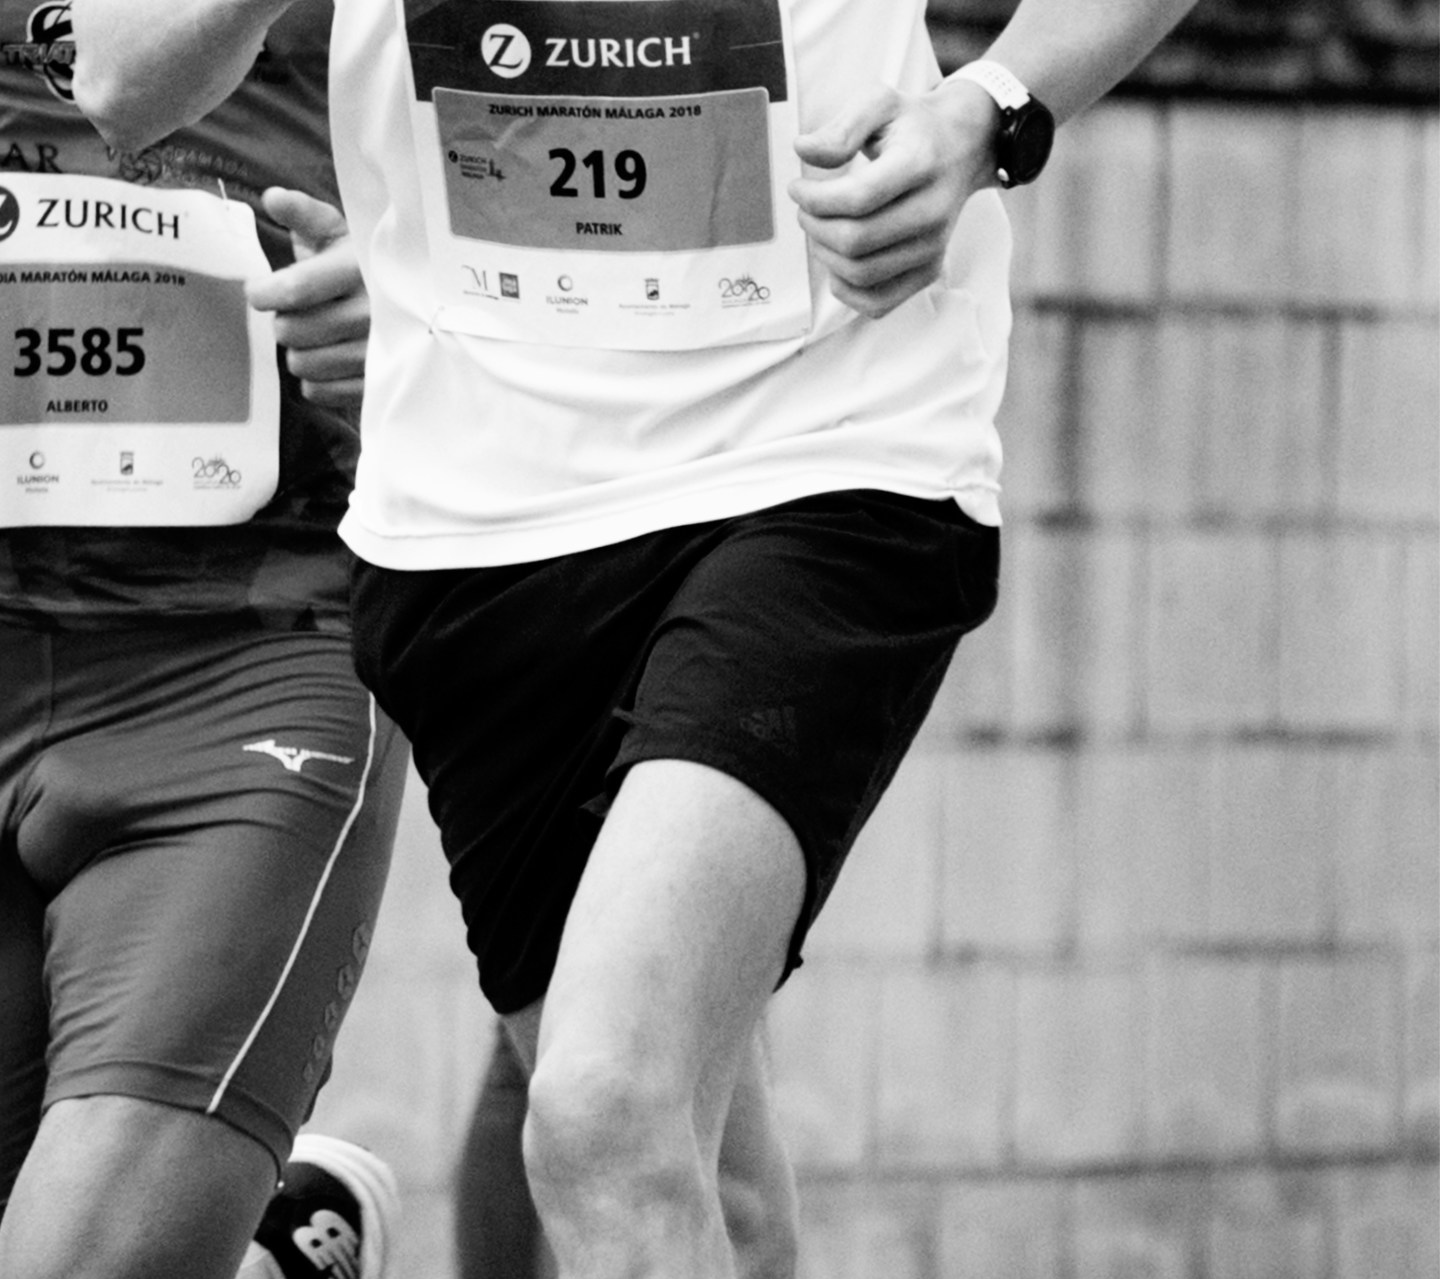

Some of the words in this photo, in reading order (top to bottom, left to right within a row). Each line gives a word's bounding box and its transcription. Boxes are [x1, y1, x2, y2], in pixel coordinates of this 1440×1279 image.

[544, 35, 693, 68] ZURICH
[488, 104, 534, 118] ZURICH
[537, 103, 602, 120] MARATÓN
[605, 101, 665, 120] MÁLAGA
[669, 104, 703, 118] 2018
[547, 146, 648, 200] 219
[36, 198, 181, 240] ZURICH
[575, 222, 623, 237] PATRIK
[20, 268, 87, 285] MARATÓN
[91, 268, 151, 285] MÁLAGA
[154, 271, 186, 287] 2018
[13, 326, 147, 377] 3585
[46, 398, 109, 414] ALBERTO
